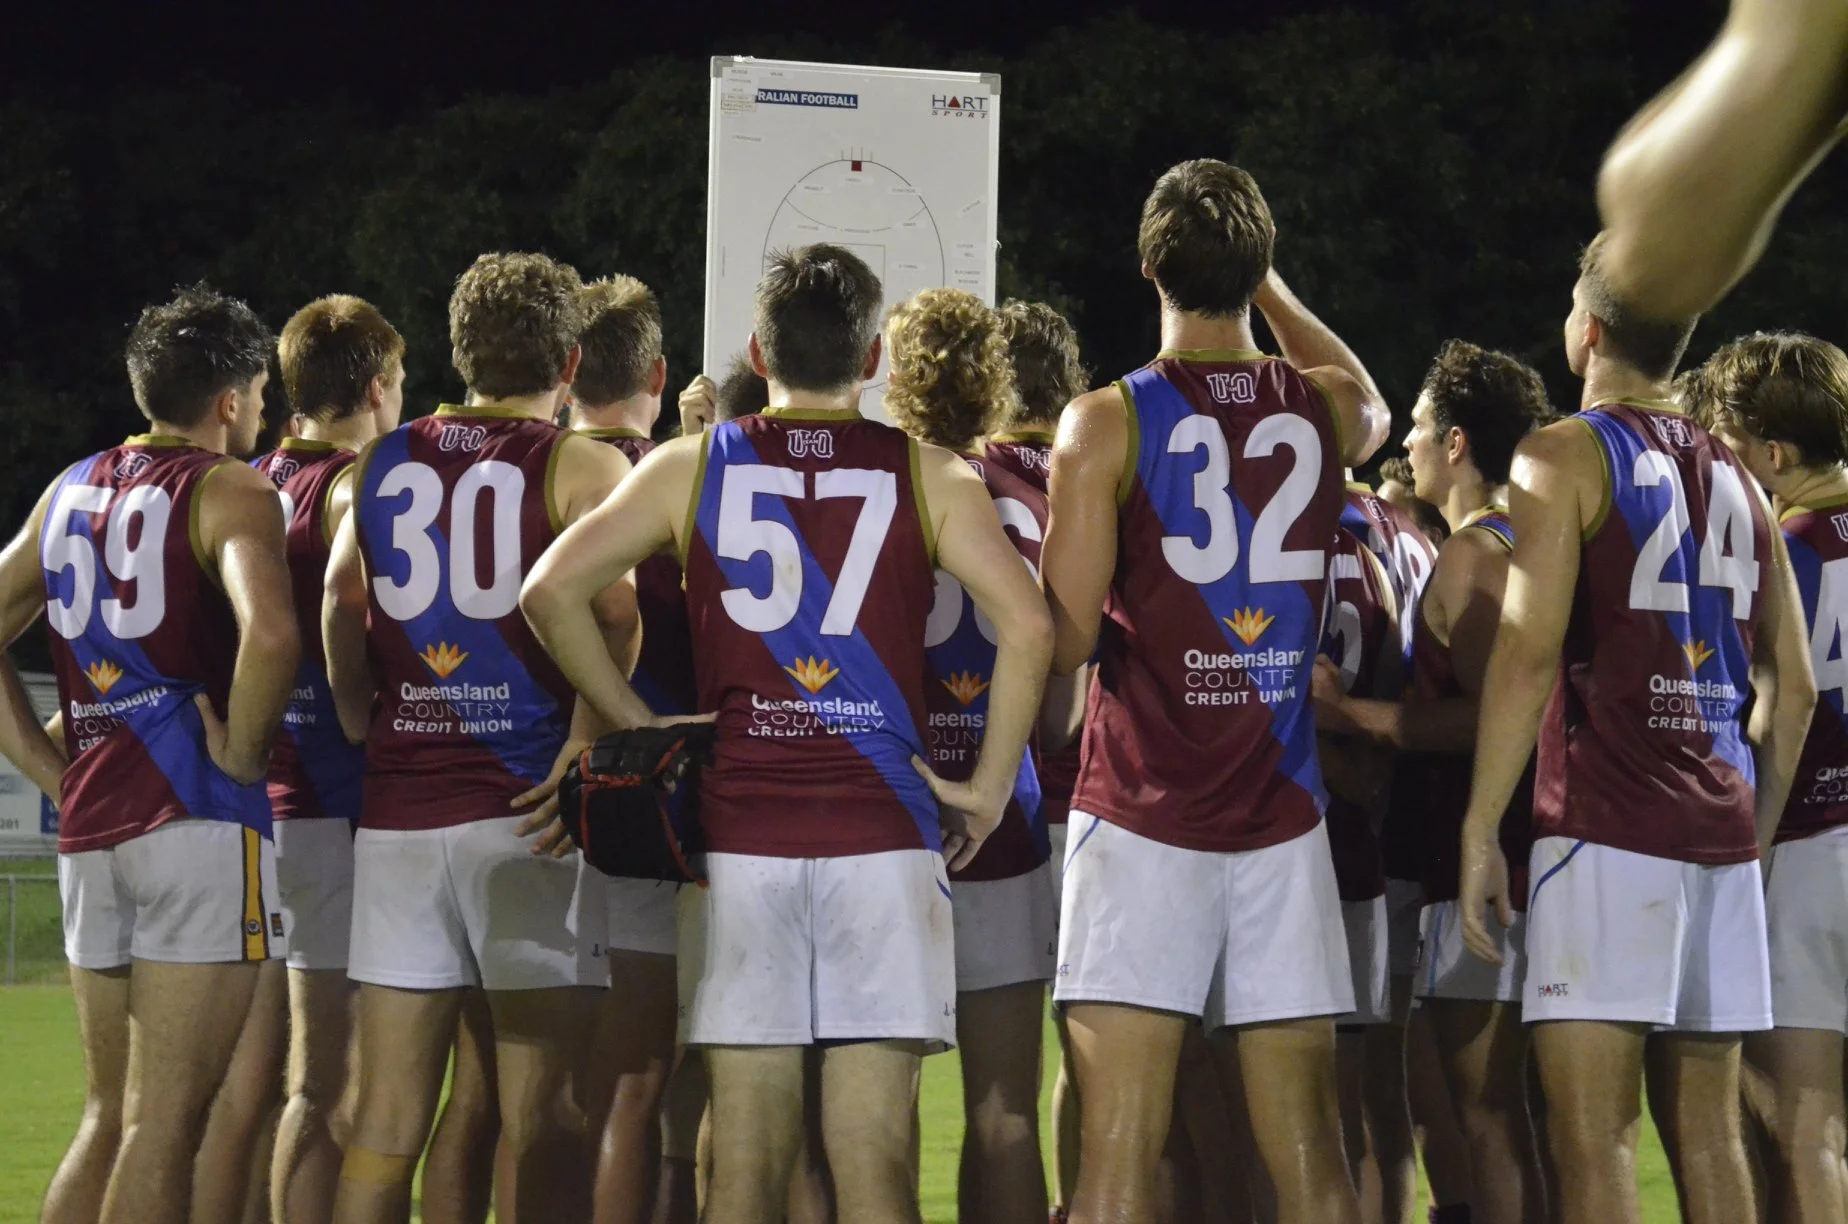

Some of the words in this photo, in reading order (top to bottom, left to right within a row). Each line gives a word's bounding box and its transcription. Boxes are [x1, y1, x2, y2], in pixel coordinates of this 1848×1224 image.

[801, 93, 857, 106] FOOTBALL
[931, 110, 987, 119] SPORT
[1160, 412, 1325, 585] 32
[372, 459, 526, 621] 30
[1629, 449, 1760, 621] 24
[716, 463, 898, 636] 57
[43, 483, 172, 639] 59
[401, 682, 510, 701] Queensland
[1185, 691, 1250, 705] CREDIT
[398, 702, 510, 718] COUNTRY
[752, 693, 884, 717] Queensland
[393, 719, 452, 733] CREDIT
[460, 719, 512, 733] UNION
[752, 711, 885, 728] COUNTRY
[1648, 716, 1698, 731] CREDIT
